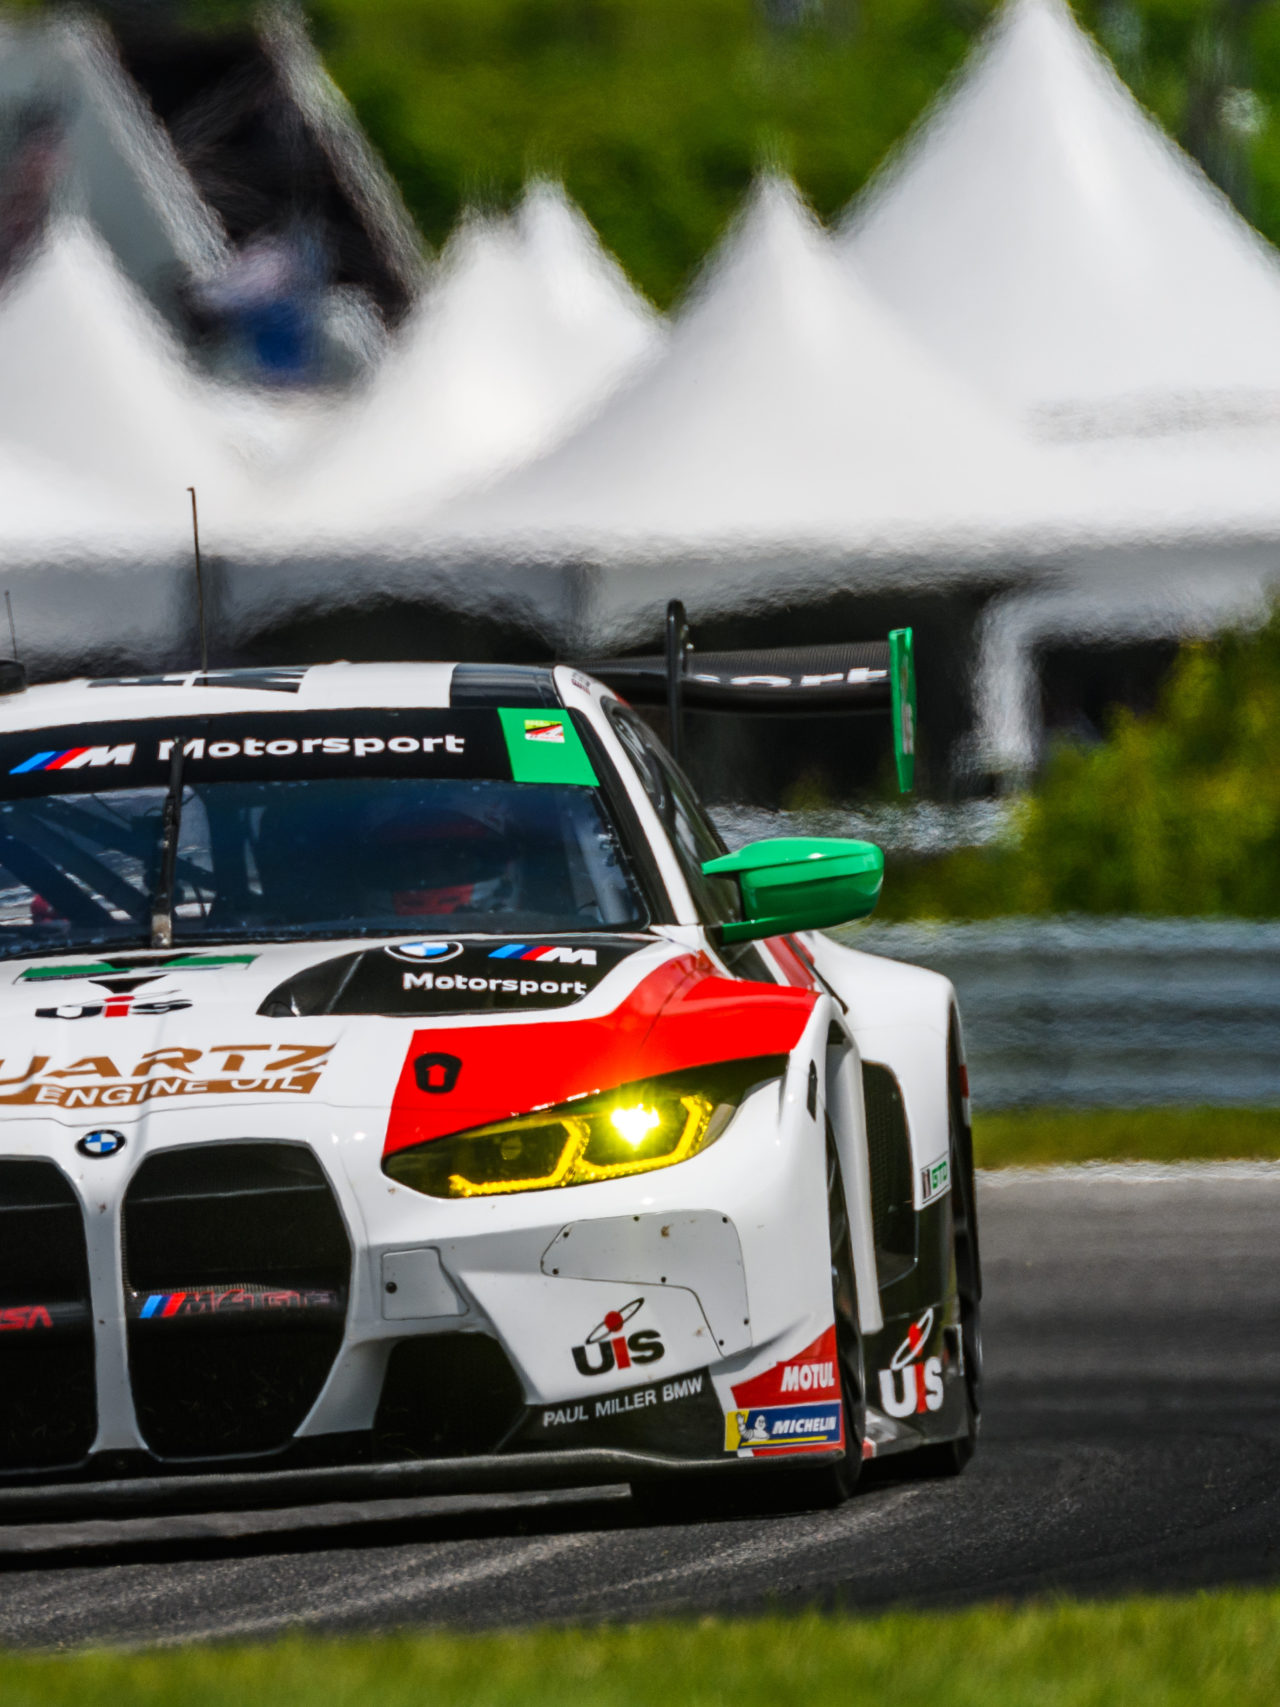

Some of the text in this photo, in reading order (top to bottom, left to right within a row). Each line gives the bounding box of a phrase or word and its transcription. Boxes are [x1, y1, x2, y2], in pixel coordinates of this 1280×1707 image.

[158, 734, 465, 760] Motorsport
[403, 972, 587, 996] Motorsport
[34, 1078, 209, 1107] ENGINE
[780, 1361, 836, 1393] MOTUL
[542, 1375, 703, 1427] PAUL MILLER BMW
[772, 1415, 837, 1435] MICHELIN
